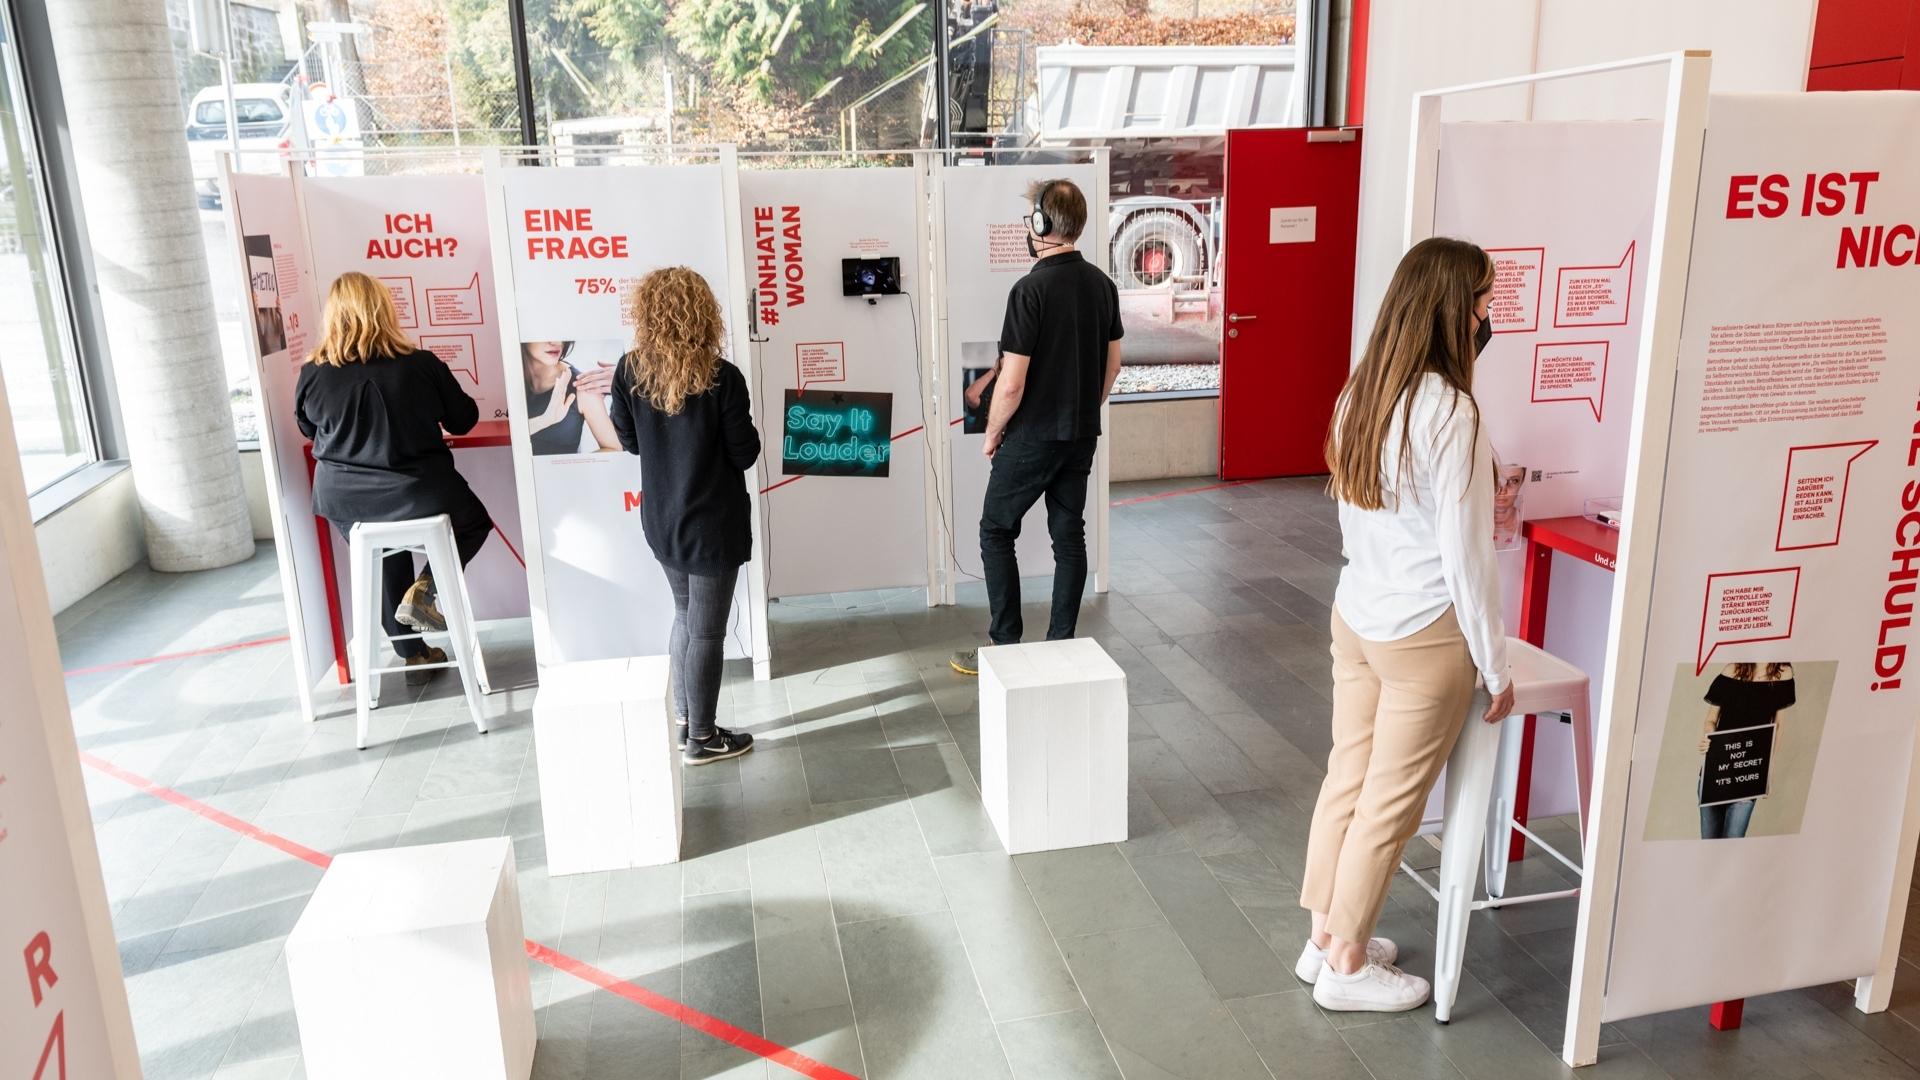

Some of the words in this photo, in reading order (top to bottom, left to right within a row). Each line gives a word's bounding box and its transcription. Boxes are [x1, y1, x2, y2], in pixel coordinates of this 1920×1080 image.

[1726, 174, 1790, 219] ES
[1801, 172, 1880, 217] IST
[385, 213, 433, 234] ICH
[524, 208, 593, 232] EINE
[366, 237, 458, 259] AUCH?
[527, 236, 629, 260] FRAGE
[782, 206, 805, 307] WOMAN
[1836, 224, 1920, 269] NIC
[755, 206, 779, 325] #UNHATE
[575, 278, 616, 294] 75%
[787, 405, 842, 438] Say
[850, 408, 872, 432] It
[783, 435, 891, 462] Louder
[1595, 553, 1609, 566] Und
[1871, 479, 1920, 692] SCHULD!
[1724, 742, 1741, 750] THIS
[1746, 740, 1753, 748] IS
[1730, 751, 1746, 760] NOT
[1718, 763, 1730, 771] MY
[1733, 758, 1763, 769] SECRET
[1735, 773, 1760, 783] YOURS
